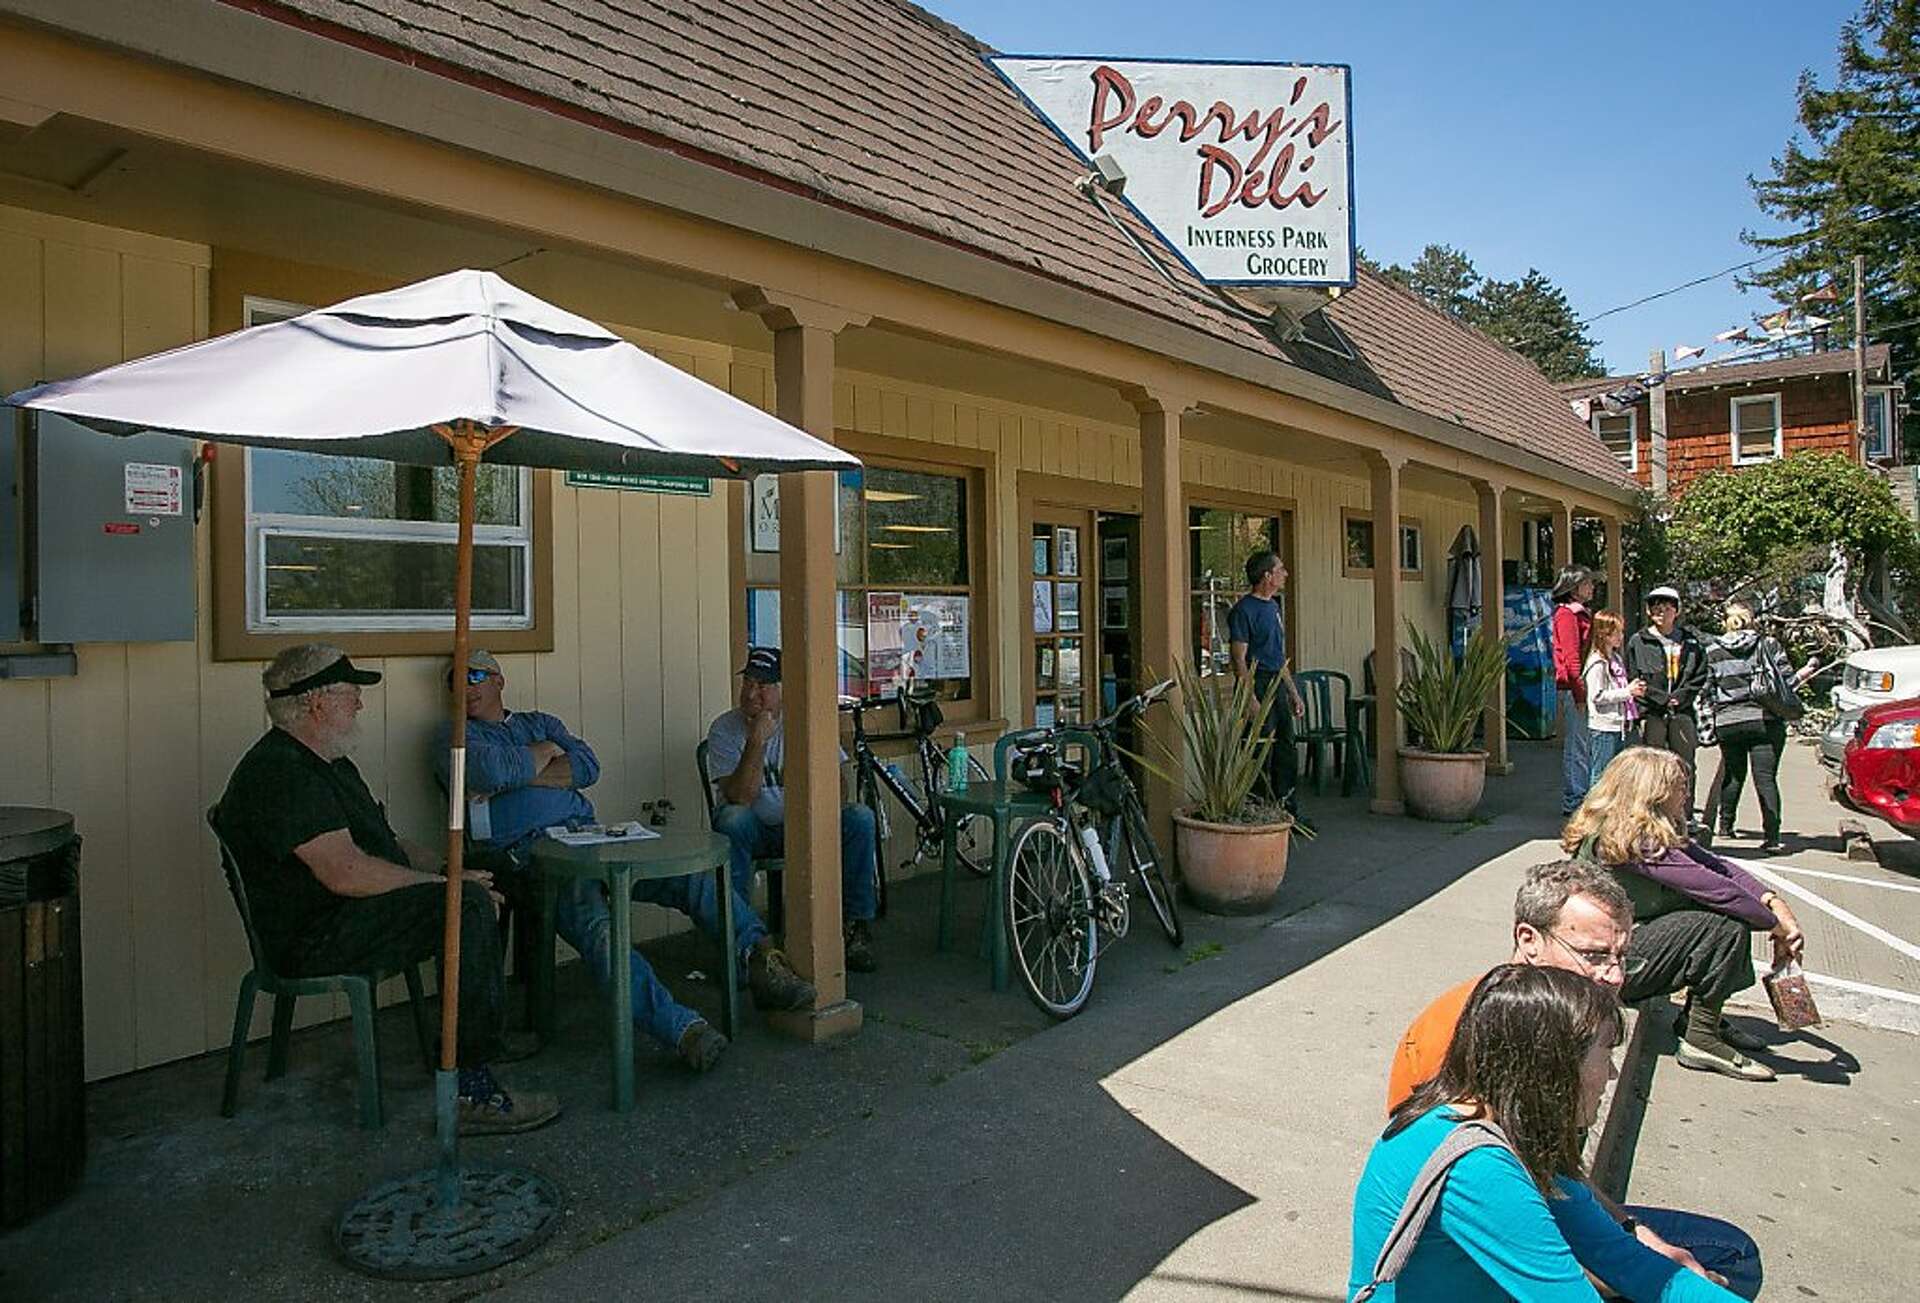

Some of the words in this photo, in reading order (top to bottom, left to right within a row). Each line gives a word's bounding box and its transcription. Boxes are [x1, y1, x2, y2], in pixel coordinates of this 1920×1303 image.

[1087, 65, 1342, 175] Perry's
[1197, 142, 1329, 219] Deli
[1187, 225, 1276, 250] INVERNESS
[1281, 226, 1328, 251] PARK
[1246, 252, 1328, 277] GROCERY
